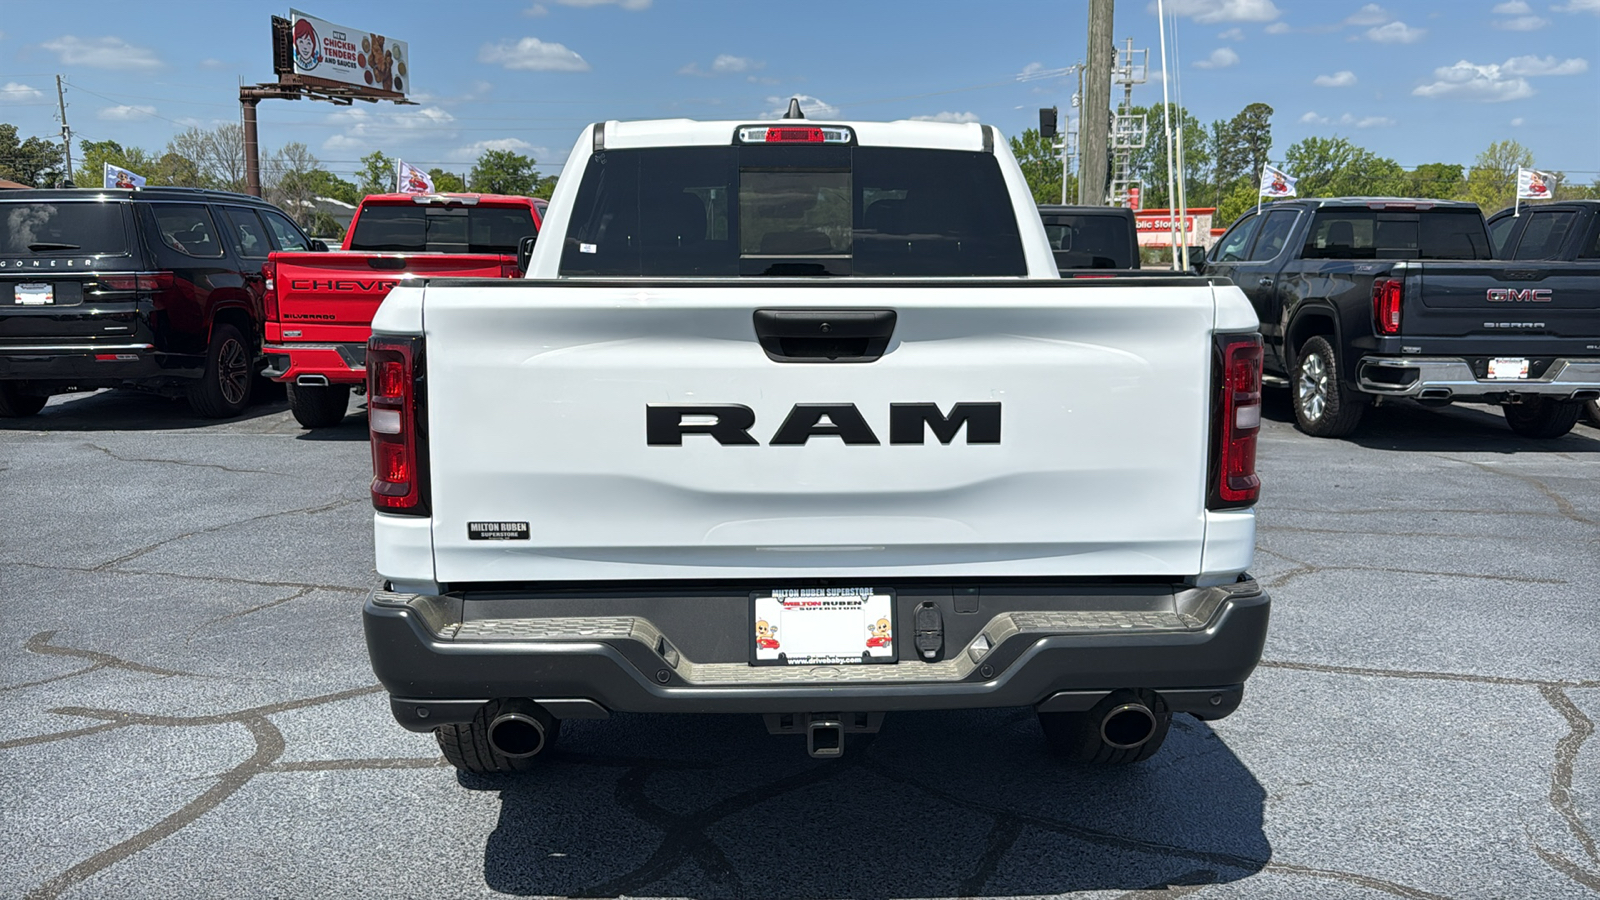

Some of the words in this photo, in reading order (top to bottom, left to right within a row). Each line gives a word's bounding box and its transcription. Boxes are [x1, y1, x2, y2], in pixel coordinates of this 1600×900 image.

[333, 32, 346, 40] NEW
[323, 37, 356, 52] CHICKEN
[323, 47, 356, 61] TENDERS
[337, 59, 357, 69] SAUCES
[1487, 288, 1552, 302] GMC
[646, 402, 1002, 447] RAM
[470, 523, 500, 532] MILTON
[500, 523, 527, 532] RUBEN
[771, 589, 799, 598] MILTON
[800, 588, 826, 597] RUBEN
[826, 587, 874, 597] SUPERSTORE
[787, 656, 862, 665] www.drivebaby.com
